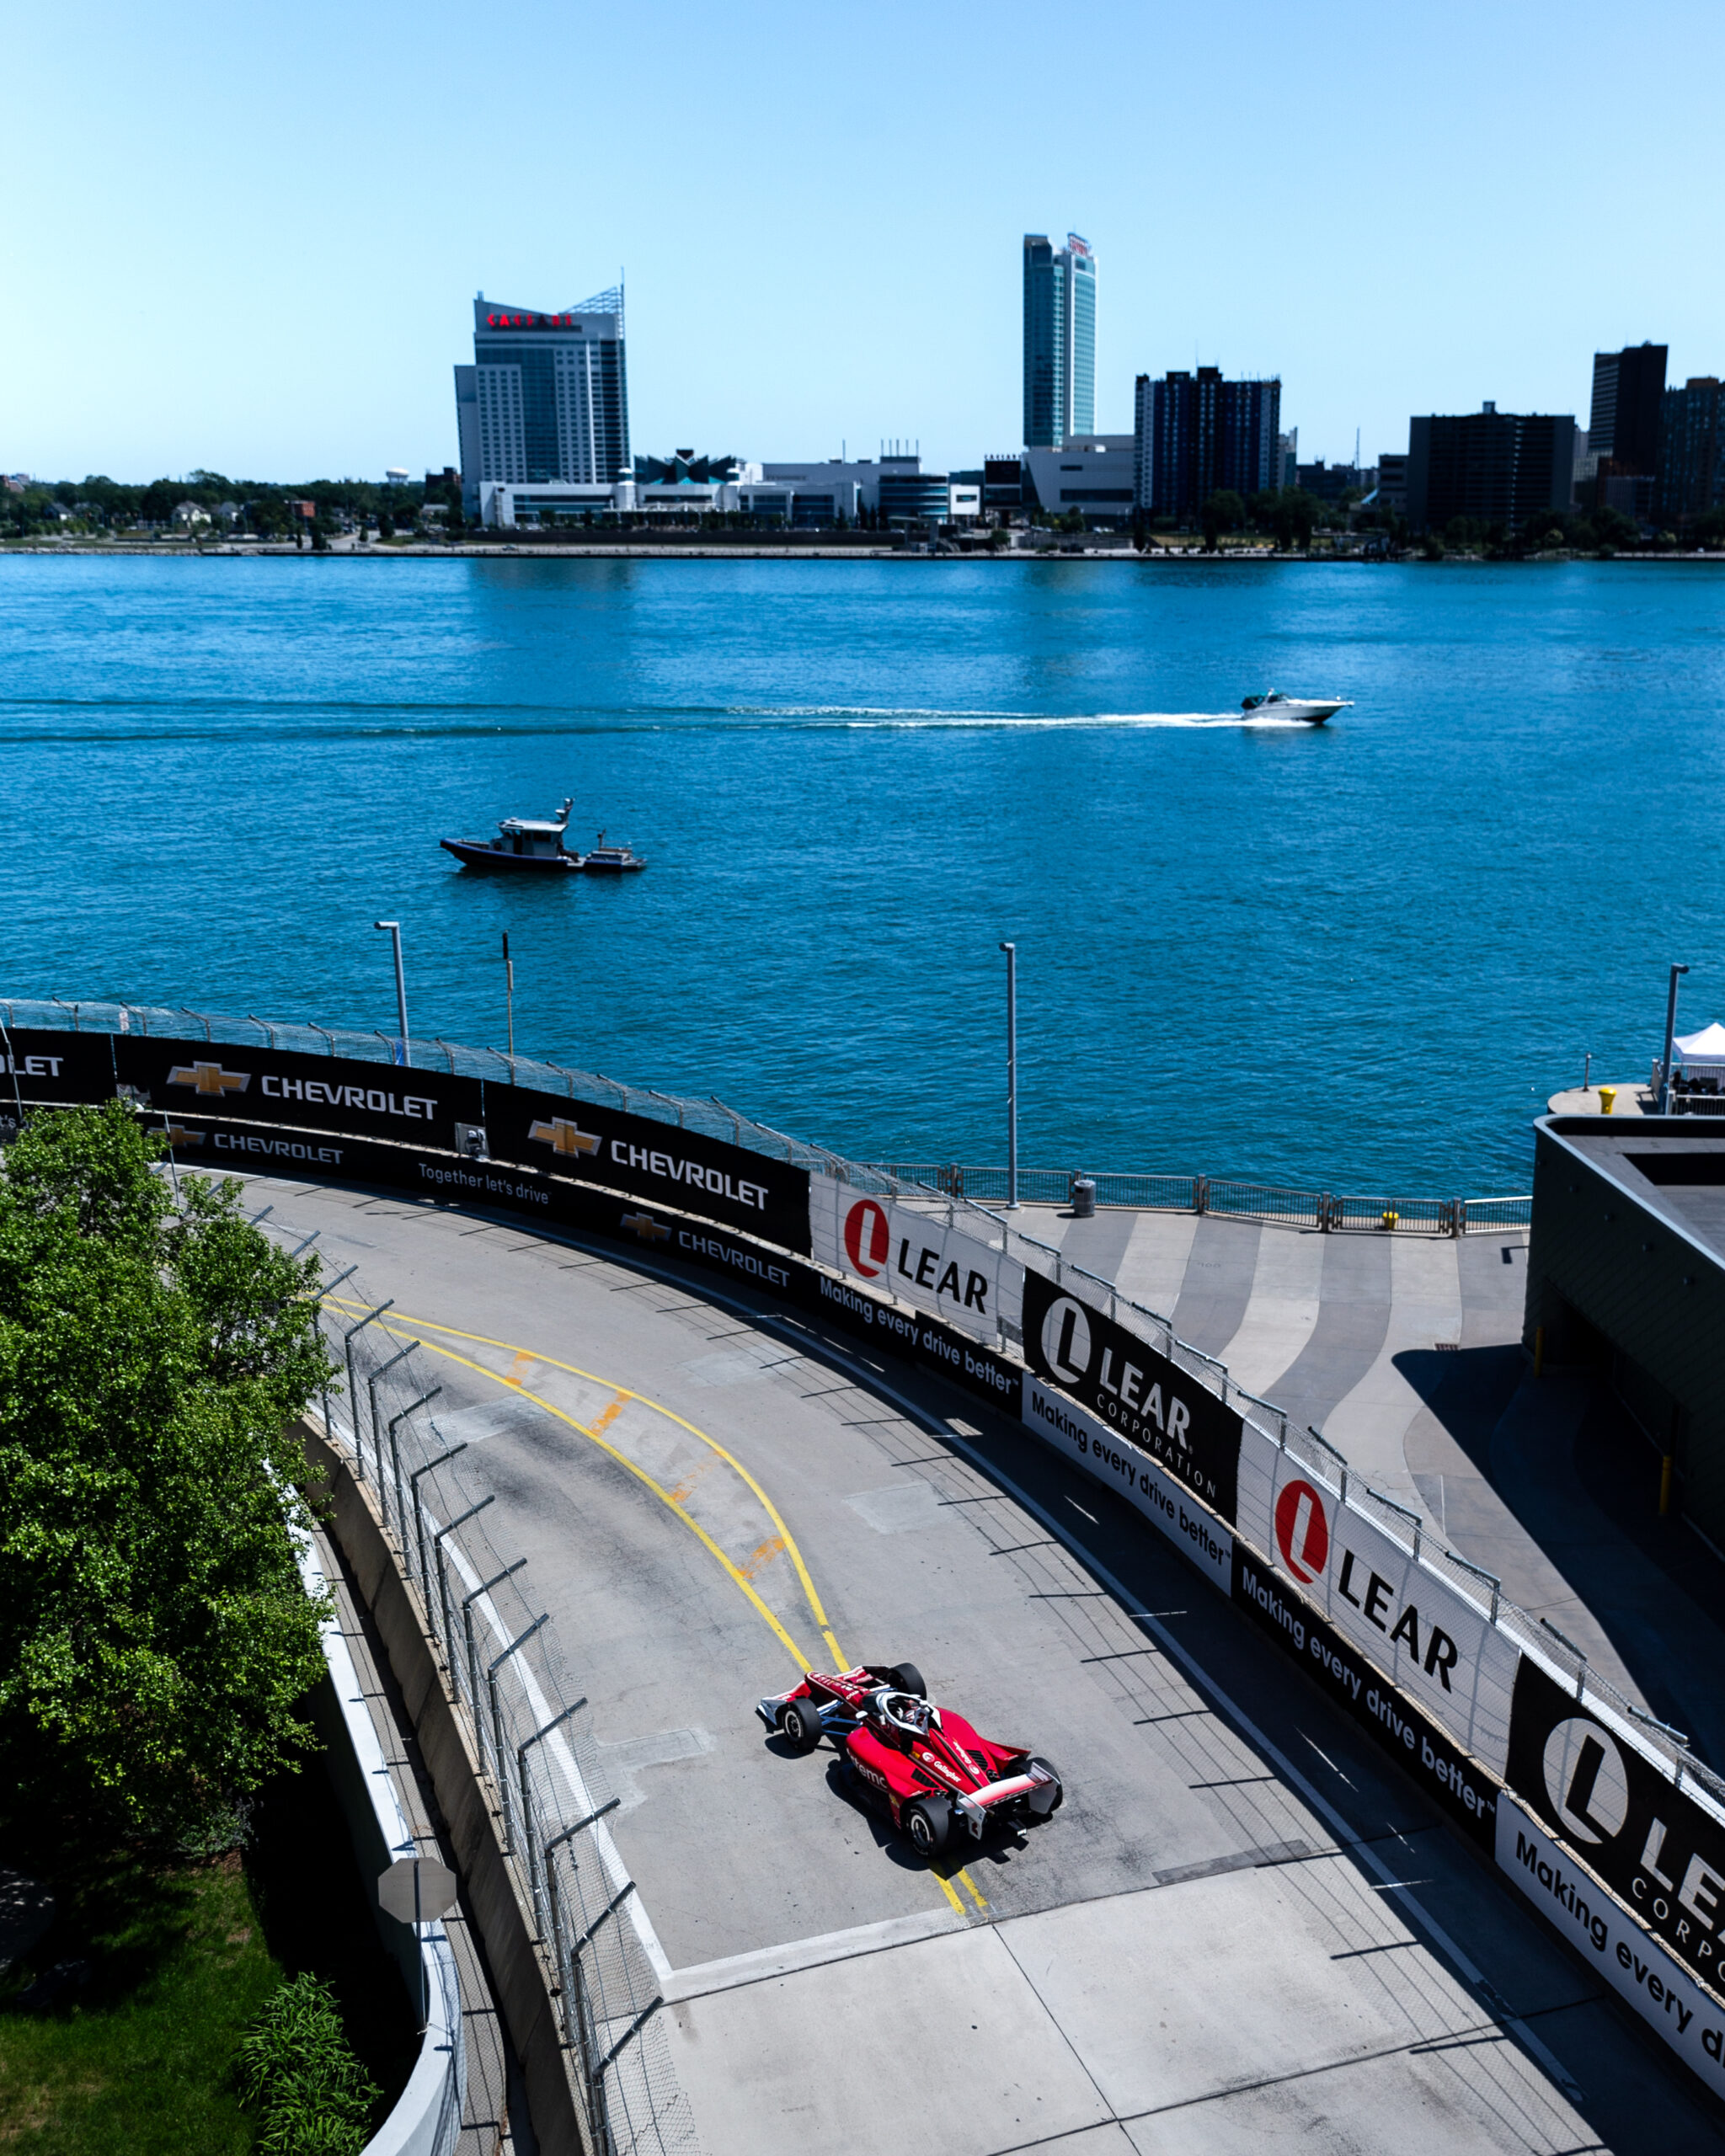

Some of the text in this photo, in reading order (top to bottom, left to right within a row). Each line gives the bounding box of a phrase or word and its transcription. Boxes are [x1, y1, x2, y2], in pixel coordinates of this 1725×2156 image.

[486, 312, 572, 327] CAESARS
[261, 1075, 438, 1120] CHEVROLET
[214, 1133, 344, 1165] CHEVROLET
[419, 1163, 549, 1204] Together let's drive
[611, 1139, 769, 1210] CHEVROLET
[679, 1230, 790, 1287] CHEVROLET
[898, 1237, 988, 1315] LEAR
[820, 1275, 874, 1324] Making
[877, 1308, 919, 1346] every
[922, 1331, 960, 1366] drive
[1099, 1347, 1191, 1451] LEAR
[1032, 1391, 1088, 1454] Making
[1092, 1439, 1136, 1486] every
[1140, 1473, 1175, 1519] drive
[1097, 1394, 1216, 1498] CORPORATION
[1242, 1565, 1306, 1650] Making
[1310, 1636, 1362, 1700] every
[1366, 1686, 1415, 1750] drive
[1338, 1549, 1459, 1694] LEAR
[1640, 1817, 1725, 1942] LE
[1515, 1830, 1725, 2069] Making every d
